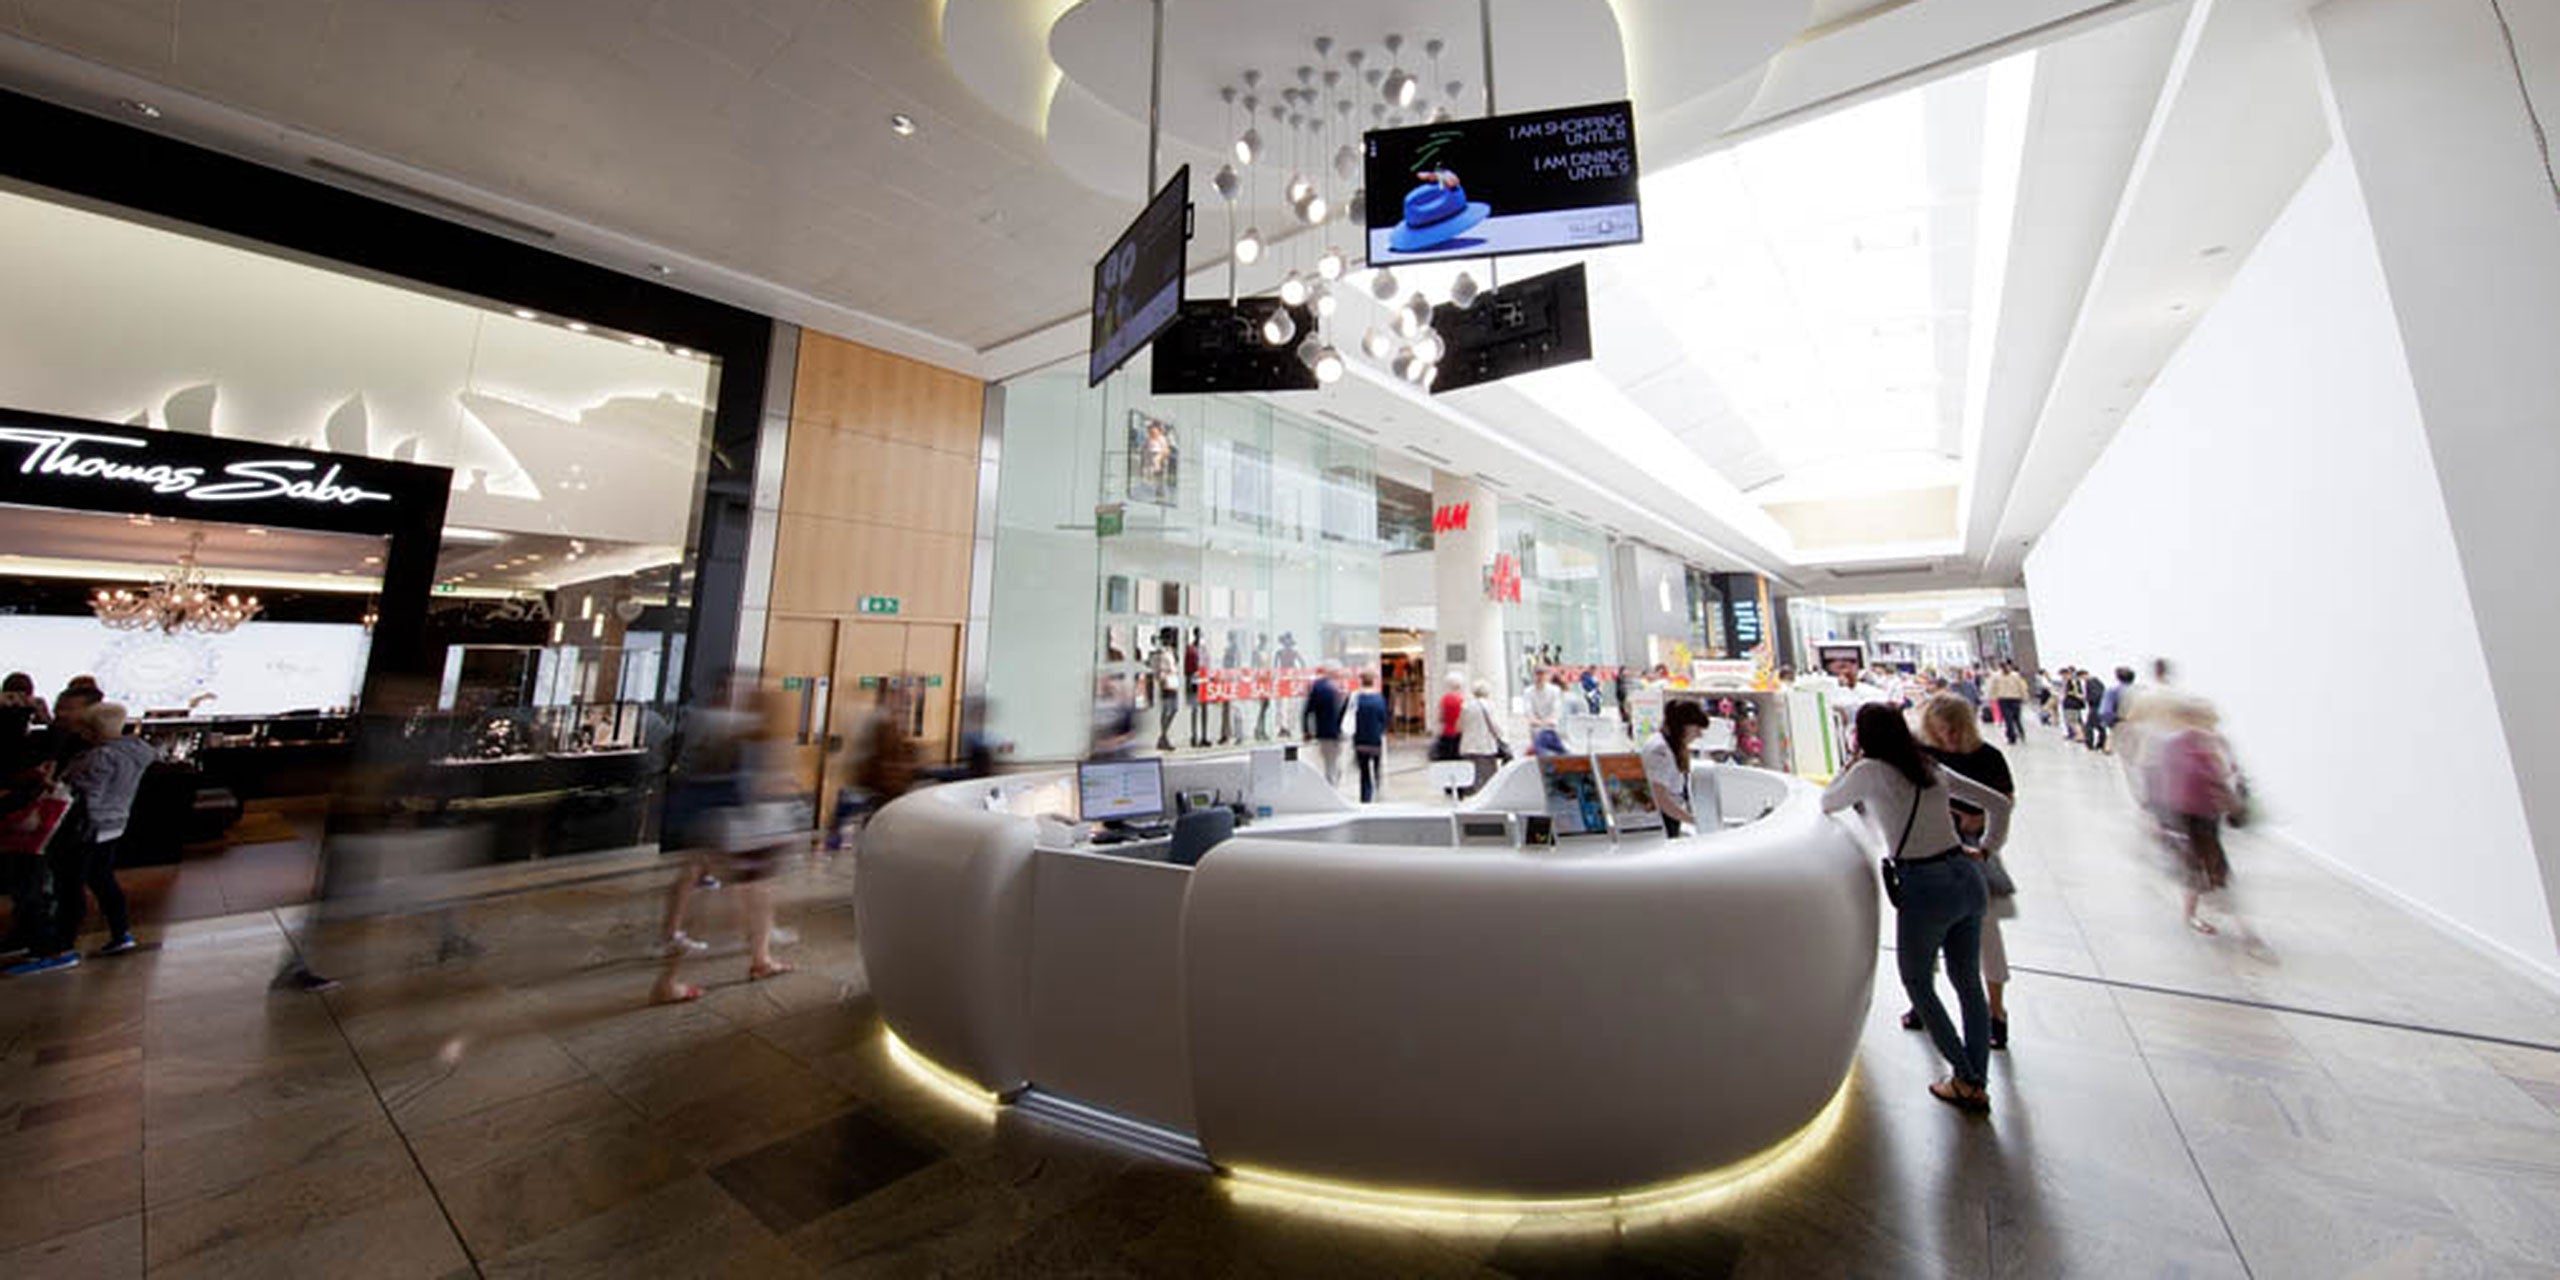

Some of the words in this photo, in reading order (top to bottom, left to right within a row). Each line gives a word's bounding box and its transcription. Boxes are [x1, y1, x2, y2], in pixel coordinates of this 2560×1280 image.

[1509, 125, 1515, 141] I
[1517, 122, 1542, 139] AM
[1544, 114, 1626, 135] SHOPPING
[1565, 130, 1614, 145] UNTIL
[1534, 156, 1540, 171] I
[1542, 154, 1568, 170] AM
[1569, 148, 1629, 167] DINING
[1568, 163, 1618, 180] UNTIL
[0, 427, 205, 493] Thomas
[185, 460, 392, 504] Sabo
[1207, 681, 1238, 700] SALE
